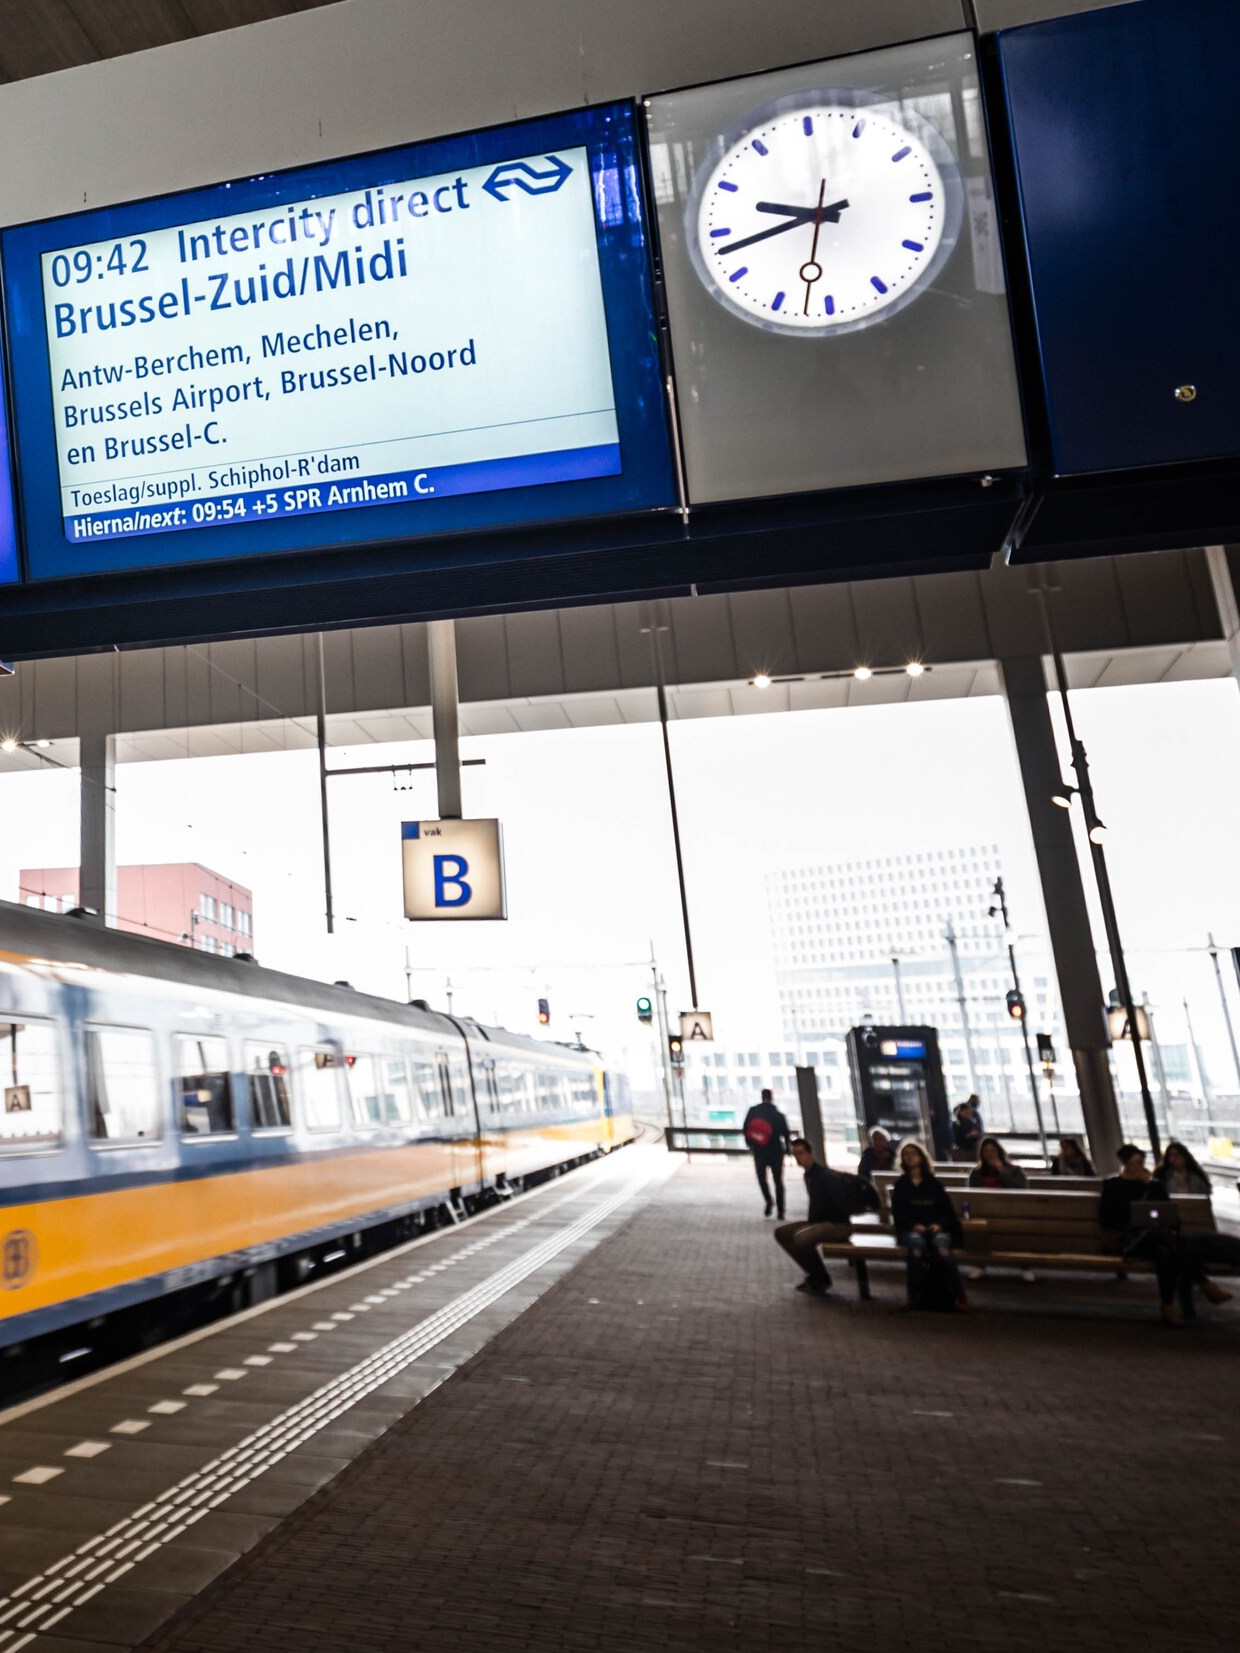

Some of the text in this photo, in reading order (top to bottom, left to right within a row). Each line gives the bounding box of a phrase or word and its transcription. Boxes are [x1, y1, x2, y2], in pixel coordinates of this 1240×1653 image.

[51, 175, 471, 288] 09:42 Intercity direct
[53, 237, 408, 339] Brussel-Zuid/Midi
[60, 317, 399, 392] Antw-Berchem, Mechelen,
[63, 338, 477, 429] Brussels Airport, Brussel-Noord
[66, 421, 227, 466] en Brussel-C.
[70, 453, 360, 508] Toeslag/suppl. Schiphol-R'dam
[74, 473, 435, 538] Hierna/next: 09:54 +5 SPR Arnhem C.
[423, 827, 442, 837] vak
[433, 854, 472, 908] B
[690, 1022, 708, 1040] A
